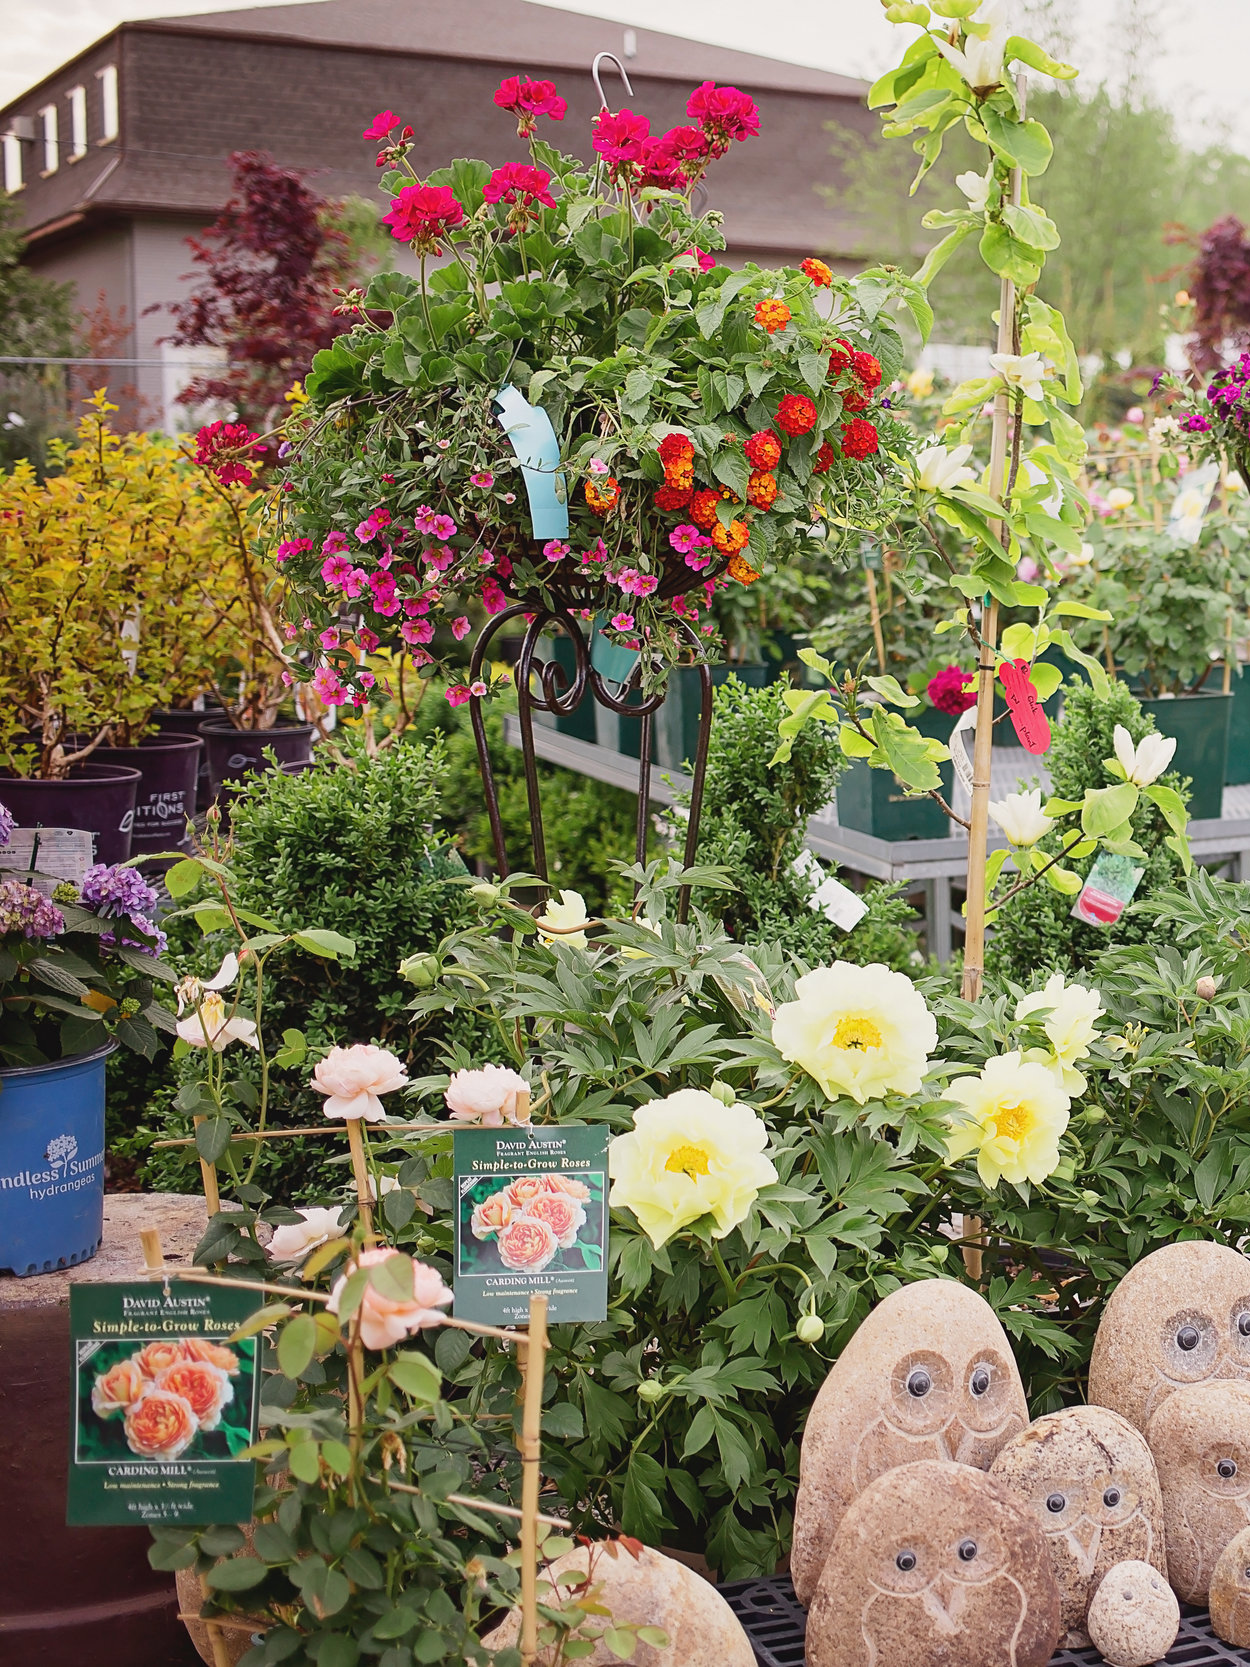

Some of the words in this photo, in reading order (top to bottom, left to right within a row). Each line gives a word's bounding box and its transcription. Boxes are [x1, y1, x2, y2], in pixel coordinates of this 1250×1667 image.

[150, 791, 185, 802] FIRST
[136, 802, 184, 819] ITIONS
[496, 1140, 526, 1150] DAVID
[472, 1158, 558, 1172] Simple-to-Grow
[561, 1157, 591, 1168] Roses
[0, 1169, 60, 1189] ndless
[30, 1173, 96, 1200] hydrangeas
[486, 1278, 528, 1286] CARDING
[122, 1298, 160, 1308] DAVID
[511, 1306, 524, 1314] high
[92, 1318, 200, 1335] Simple-to-Grow
[204, 1318, 240, 1332] Roses
[108, 1464, 158, 1476] CARDING
[103, 1482, 118, 1490] Low
[166, 1480, 188, 1490] Strong
[138, 1502, 152, 1511] high
